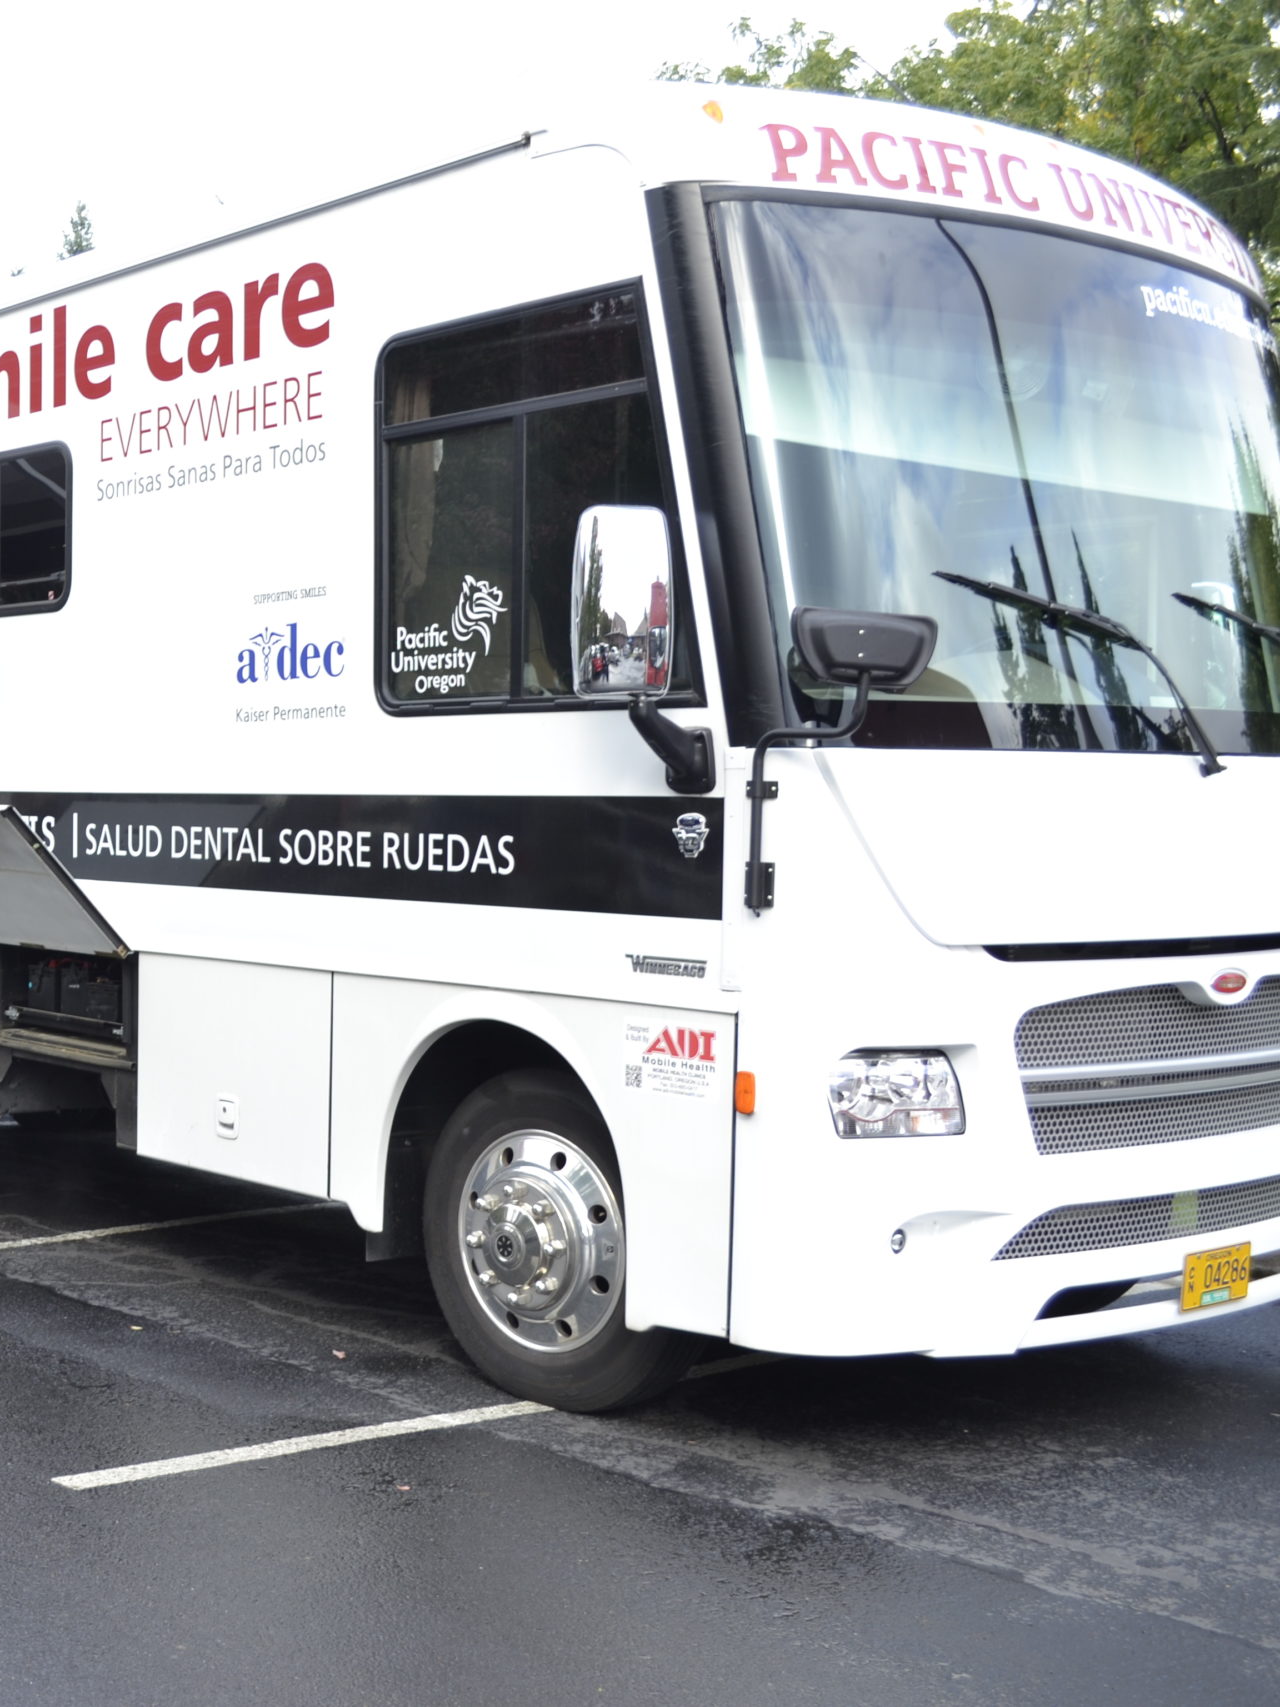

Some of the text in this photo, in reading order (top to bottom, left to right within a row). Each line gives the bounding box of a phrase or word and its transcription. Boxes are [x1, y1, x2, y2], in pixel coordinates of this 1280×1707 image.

[759, 123, 1040, 212] PACIFIC
[145, 262, 335, 382] care
[100, 371, 324, 463] EVERYWHERE
[96, 439, 326, 501] Sonrisas Sanas Para Todos
[253, 586, 327, 605] SUPPORTING SMILES
[396, 623, 449, 650] Pacific
[391, 647, 477, 673] University
[415, 674, 466, 694] Oregon
[235, 705, 346, 723] Kaiser Permanente
[85, 823, 163, 858] SALUD
[170, 825, 272, 864] DENTAL
[279, 828, 372, 868] SOBRE
[383, 832, 516, 876] RUEDAS
[625, 953, 708, 979] WINNEBAGO
[643, 1025, 717, 1063] ADI
[642, 1056, 716, 1073] Mobile Health
[1204, 1256, 1249, 1288] 04286
